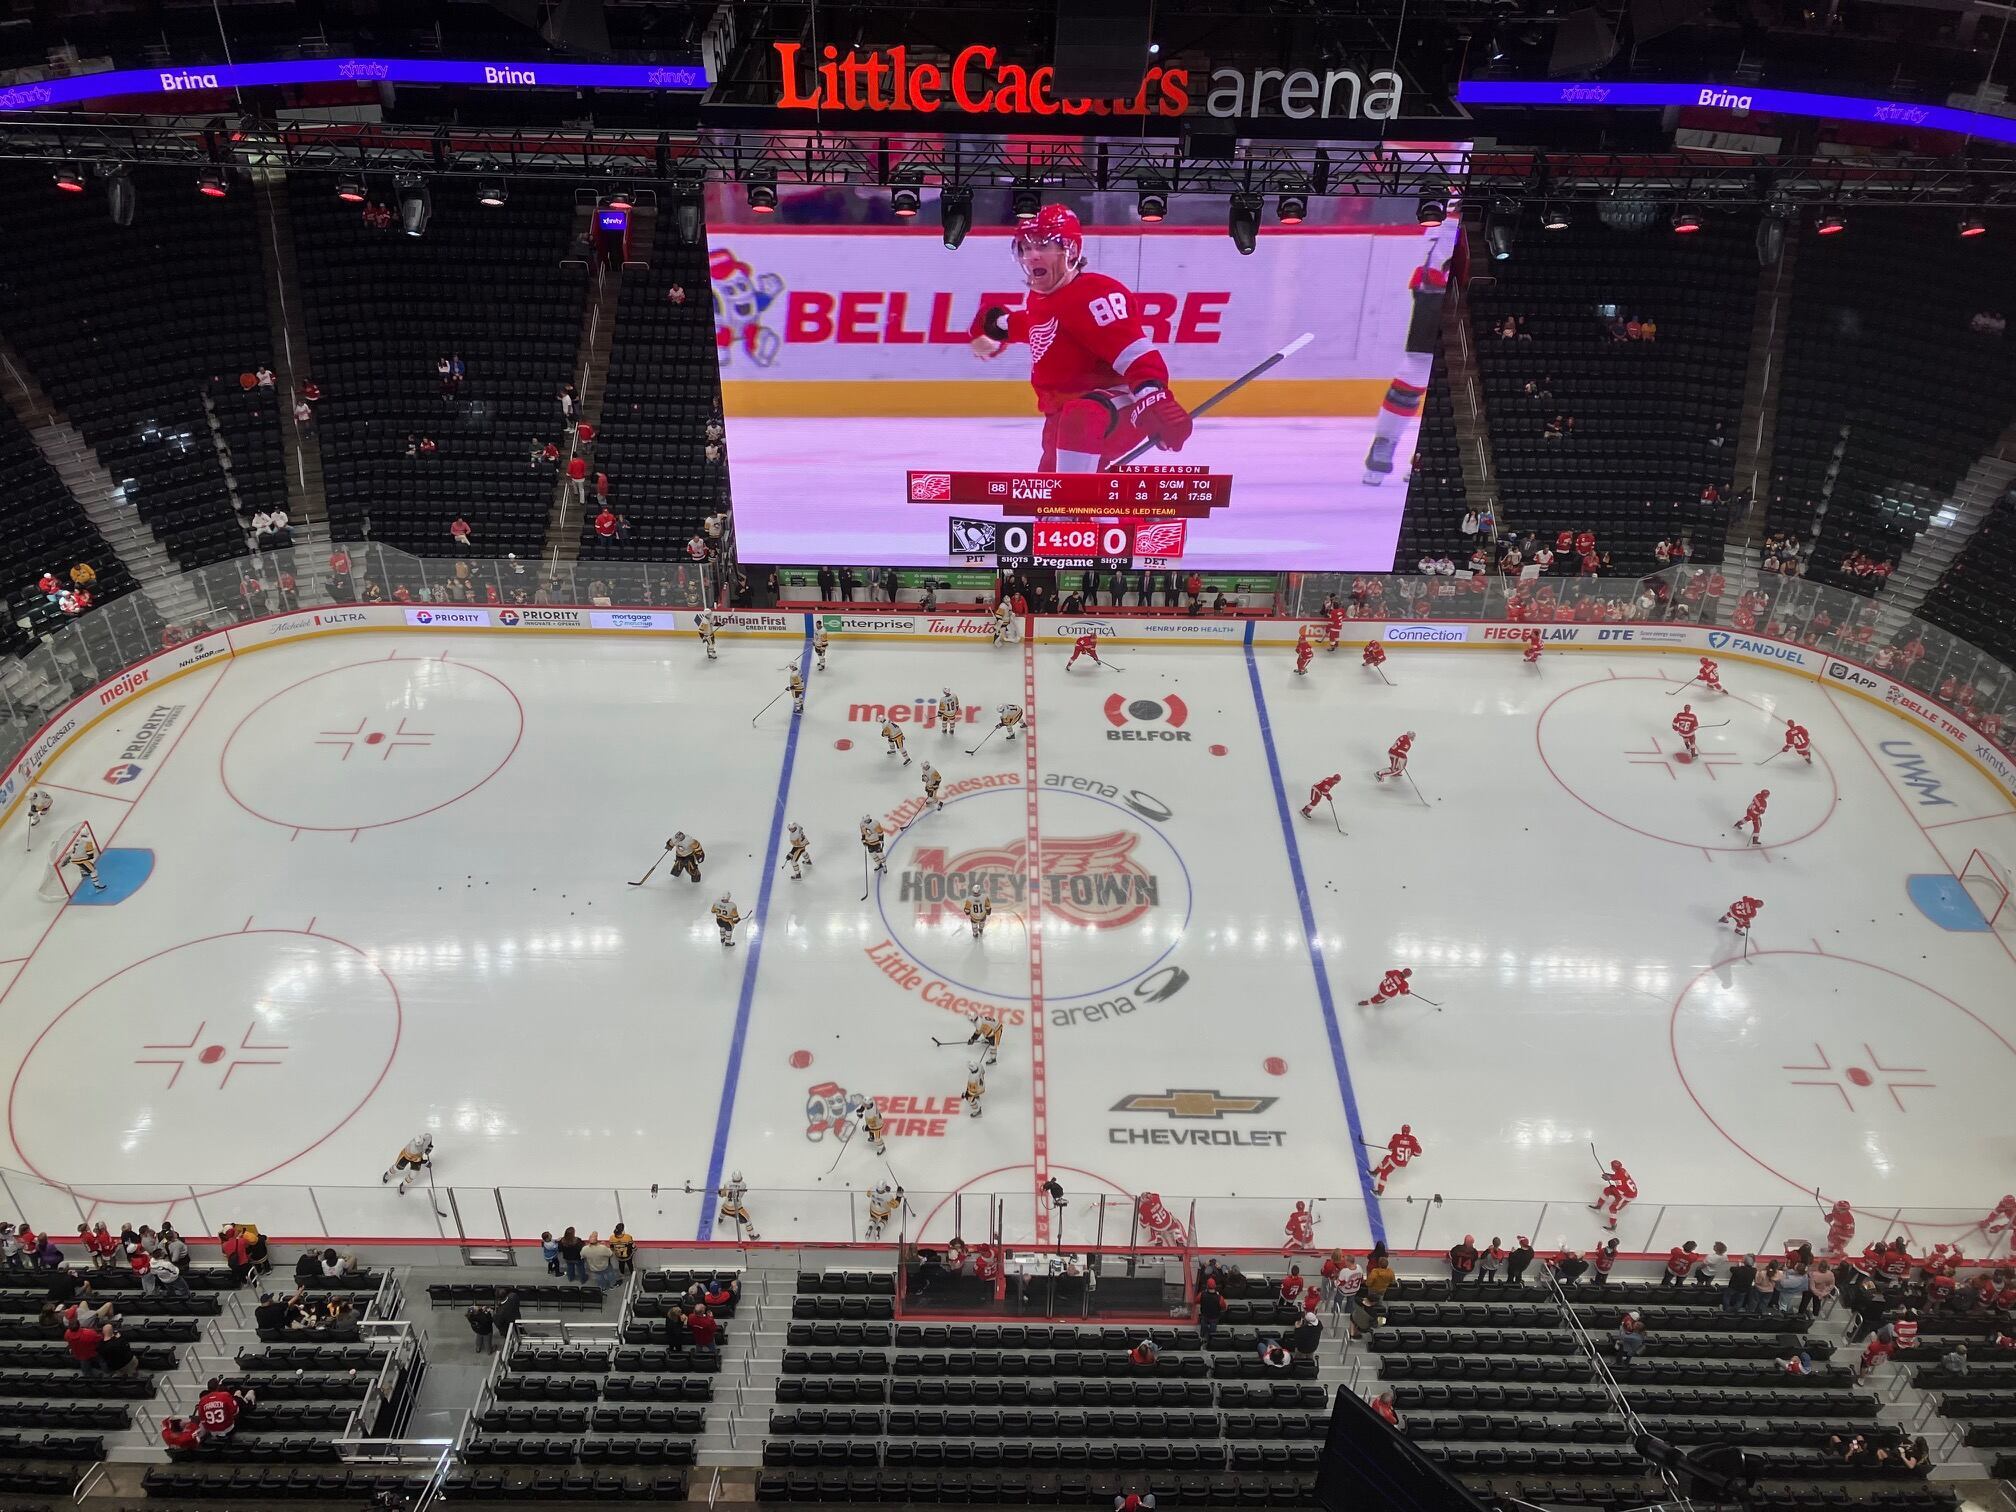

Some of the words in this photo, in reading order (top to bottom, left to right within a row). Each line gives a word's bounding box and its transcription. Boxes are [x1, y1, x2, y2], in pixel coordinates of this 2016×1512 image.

[773, 42, 942, 113] Little
[951, 44, 1189, 117] Caers
[1206, 66, 1405, 120] arena
[1089, 292, 1129, 327] 88
[991, 483, 1006, 493] 88
[1012, 479, 1062, 489] PATRICK
[1110, 480, 1119, 489] G
[1138, 480, 1147, 489] A
[1159, 480, 1185, 490] S/GM
[1192, 480, 1211, 489] TOI
[1012, 488, 1053, 499] KANE
[1108, 492, 1119, 500] 21
[1135, 492, 1148, 501] 38
[1163, 492, 1178, 501] 2.4
[1188, 492, 1213, 502] 17:58
[1043, 507, 1102, 516] GAME-WINNING
[1103, 508, 1130, 516] GOALS
[1132, 507, 1150, 516] (LED
[1151, 508, 1177, 516] TEAM)
[1004, 526, 1028, 554] 0
[1036, 530, 1096, 548] 14:08
[1103, 527, 1127, 555] 0
[966, 555, 985, 563] PIT
[1033, 556, 1094, 569] Pregame
[1144, 557, 1168, 566] DET
[324, 613, 367, 624] ULTRA
[435, 614, 479, 622] PRIORITY
[523, 611, 579, 620] PRIORITY
[761, 616, 786, 625] First
[824, 618, 914, 630] enterprise
[927, 619, 954, 634] Tim
[956, 619, 996, 634] Horto
[1388, 628, 1464, 641] Connection
[1598, 629, 1635, 641] DTE
[1732, 638, 1806, 665] FANDUEL
[100, 668, 149, 706] meijer
[1900, 697, 1939, 724] BELLE
[1940, 719, 1969, 743] TIRE
[120, 705, 172, 760] PRIORITY
[1106, 729, 1192, 742] BELFOR
[29, 745, 48, 768] Little
[46, 719, 76, 748] Caesars
[1975, 744, 2009, 777] xfinity
[1879, 741, 1955, 806] UWM
[1043, 771, 1119, 799] arena
[1041, 871, 1160, 907] TOWN
[971, 902, 984, 914] 81
[864, 939, 922, 991] Little
[1051, 994, 1137, 1028] arena
[1108, 1128, 1287, 1147] CHEVROLET
[205, 1409, 225, 1425] 93
